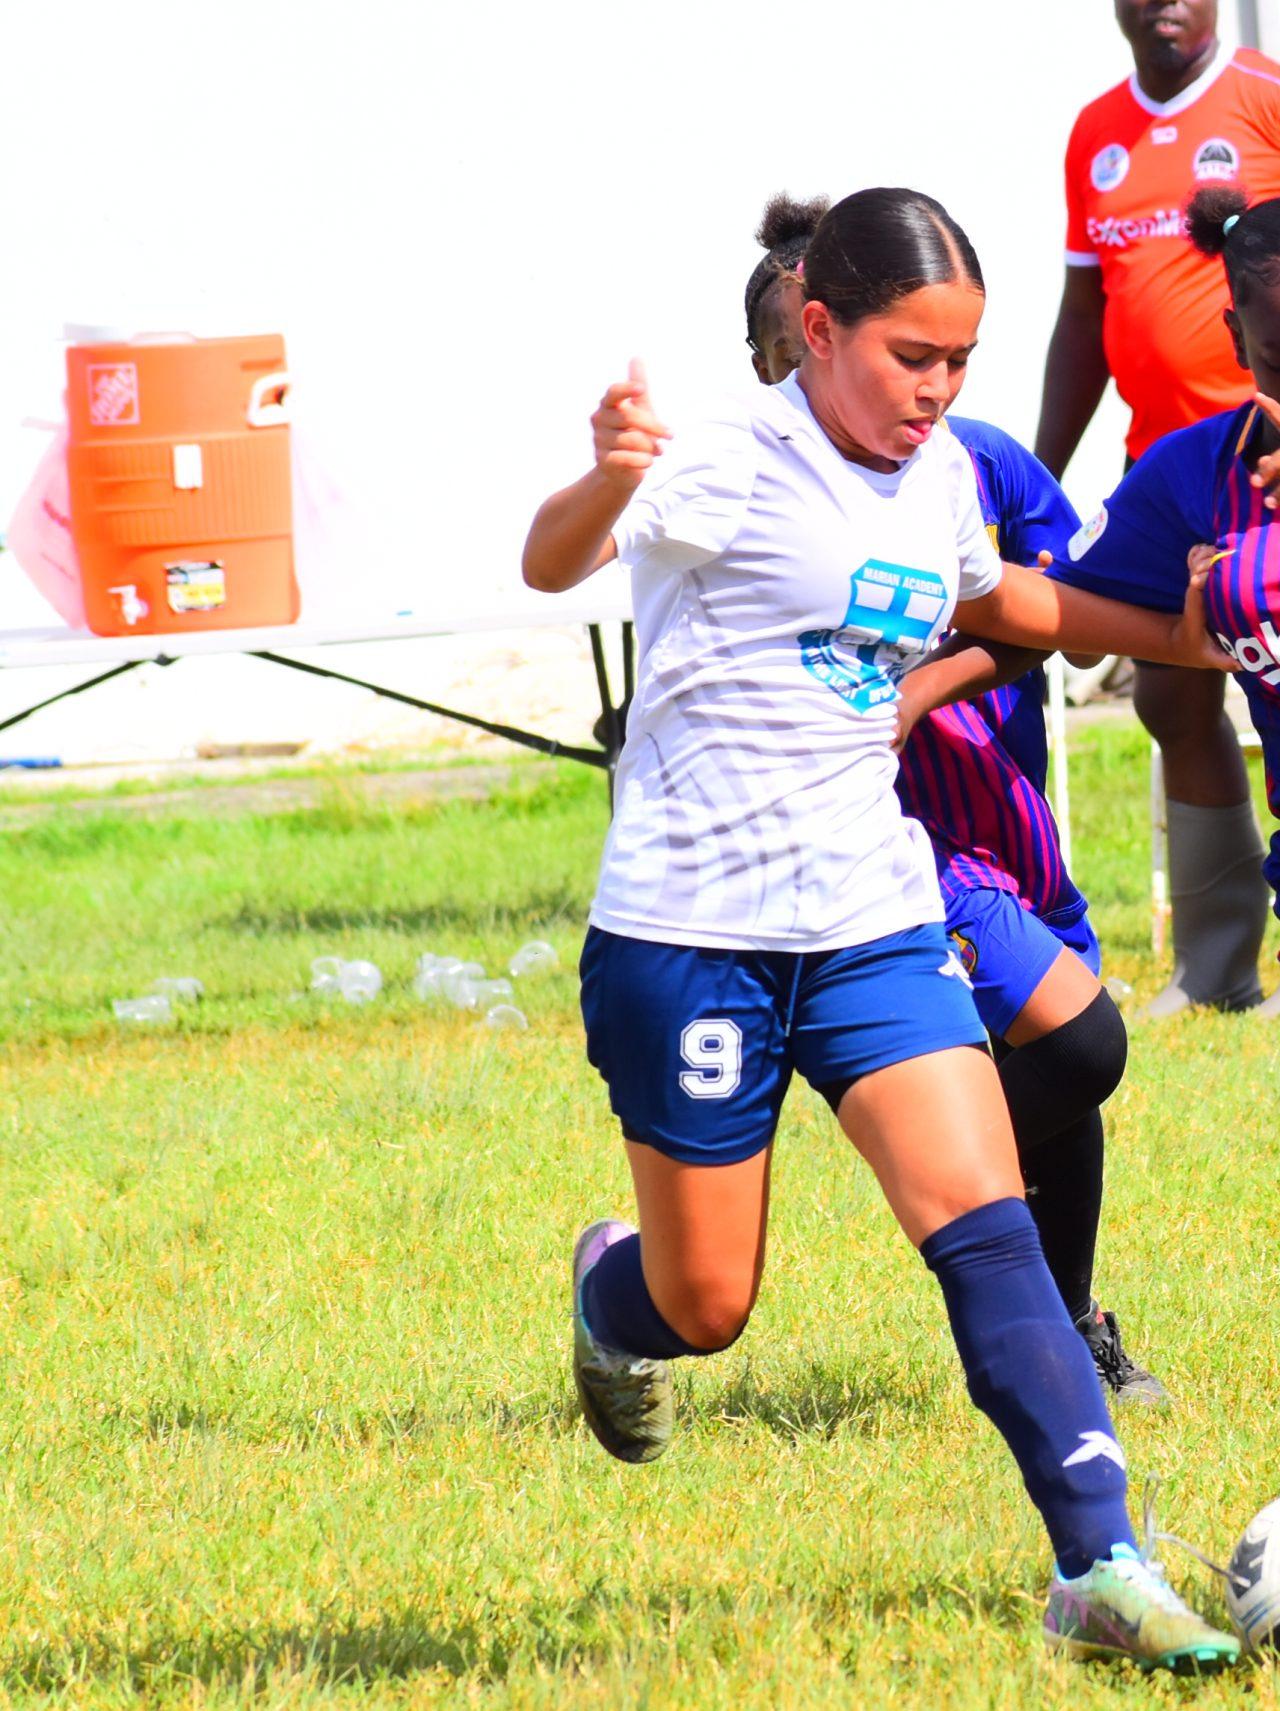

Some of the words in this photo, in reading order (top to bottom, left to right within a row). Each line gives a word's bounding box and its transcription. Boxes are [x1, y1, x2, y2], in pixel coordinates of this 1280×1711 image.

[863, 567, 901, 587] MARIAN
[902, 576, 945, 597] ACADEMY
[679, 1018, 743, 1099] 9
